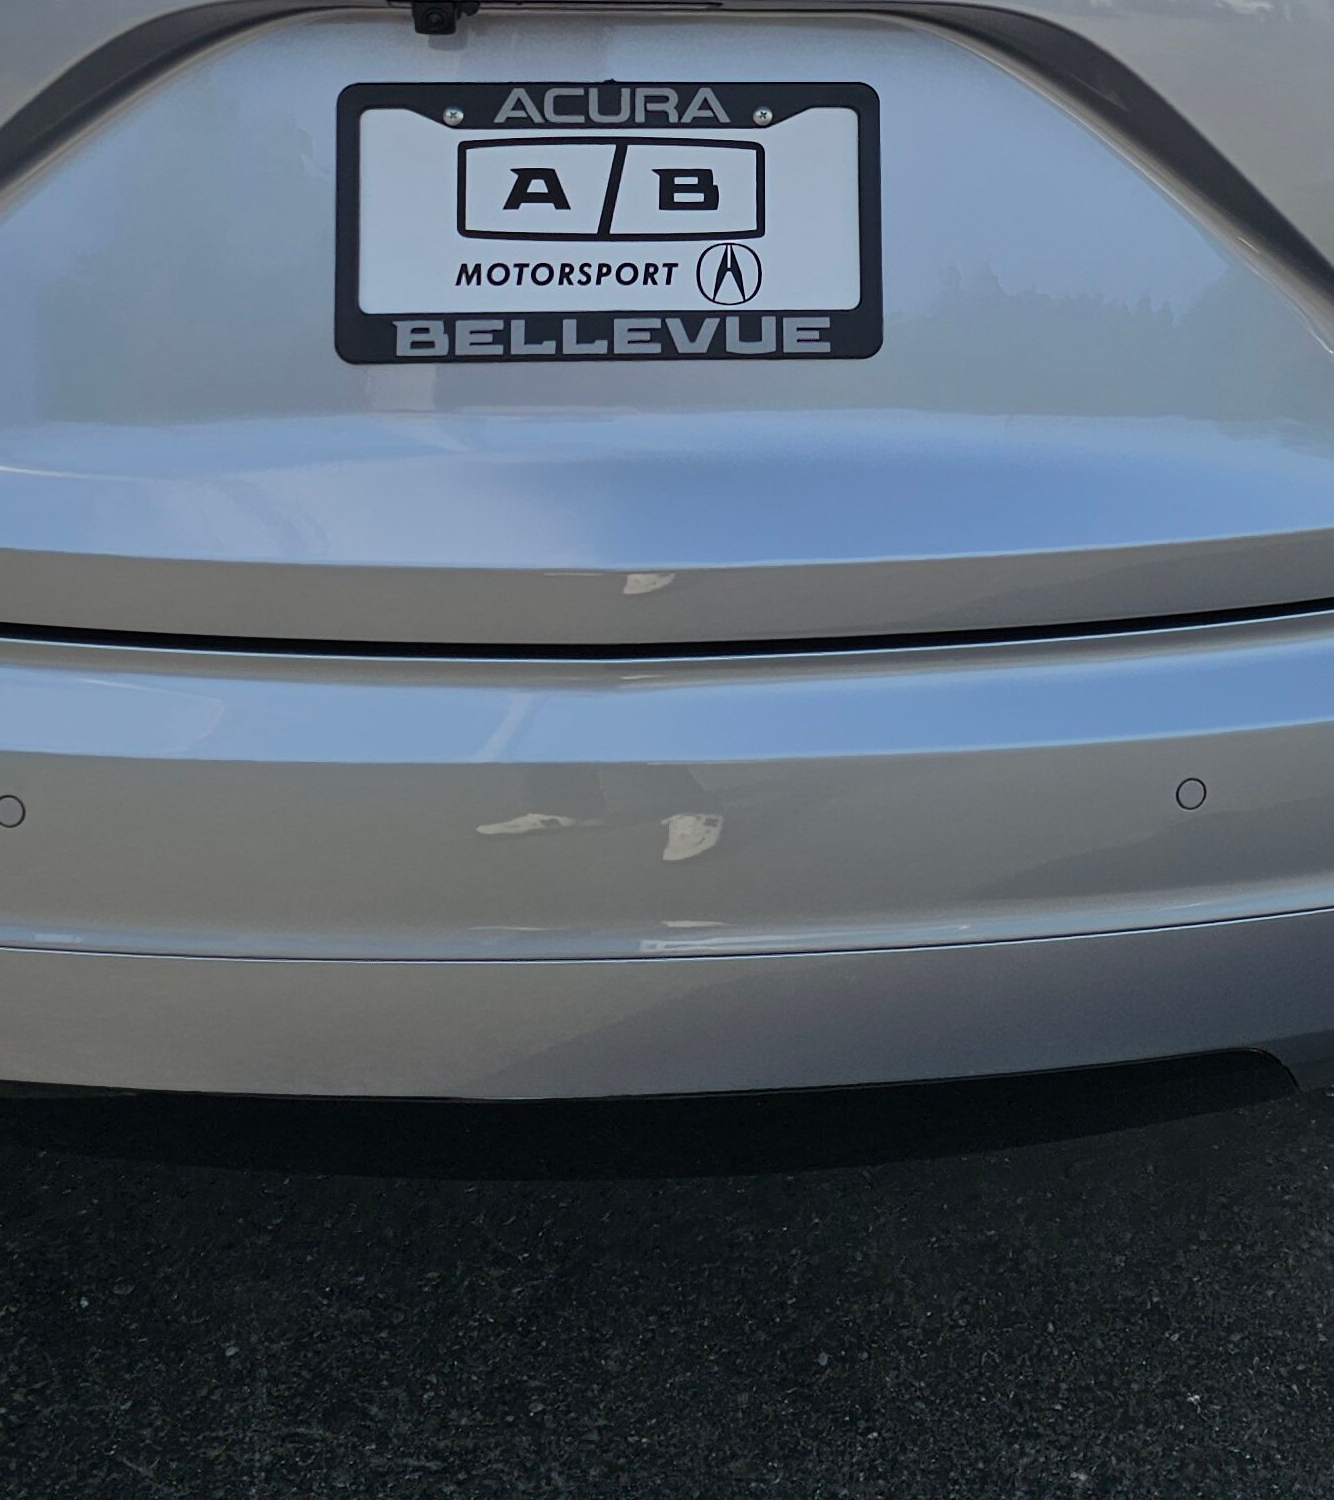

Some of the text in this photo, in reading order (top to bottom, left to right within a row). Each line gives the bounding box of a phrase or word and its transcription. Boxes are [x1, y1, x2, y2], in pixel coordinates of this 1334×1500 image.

[493, 87, 731, 124] ACURA
[455, 261, 679, 287] MOTORSPORT
[391, 316, 831, 358] BELLEVUE
